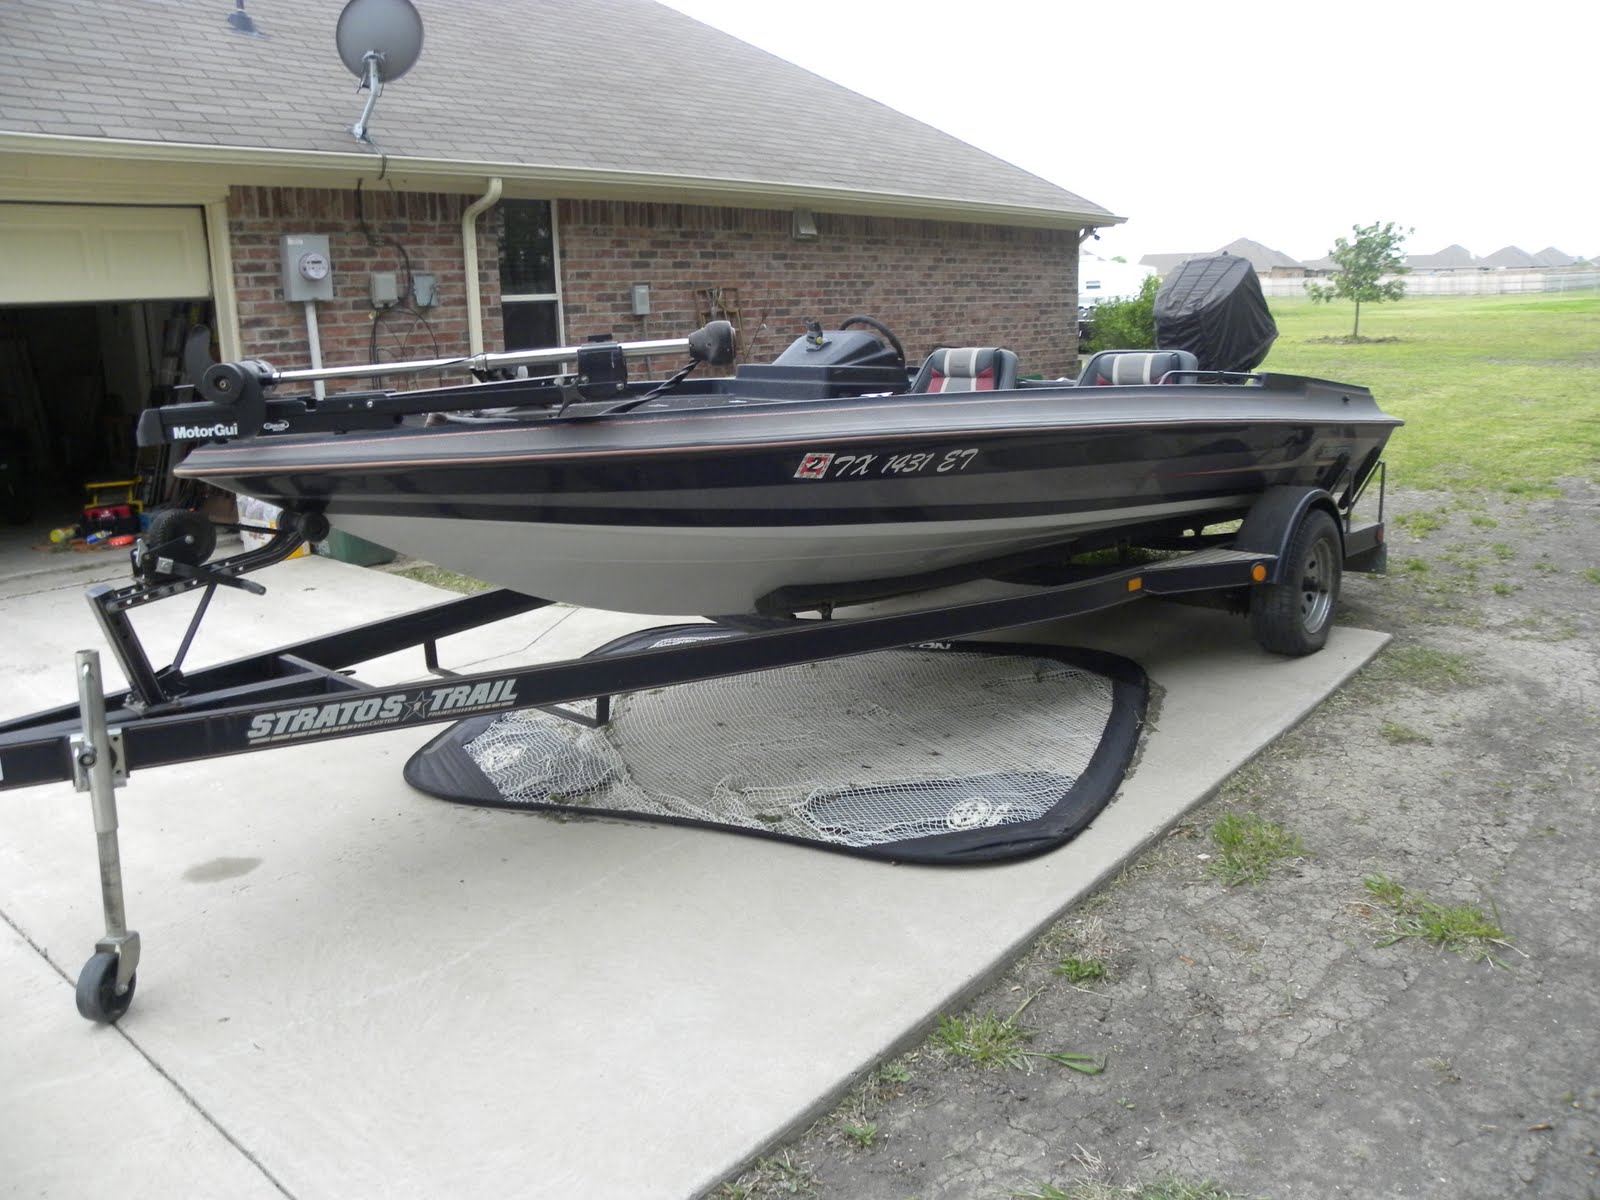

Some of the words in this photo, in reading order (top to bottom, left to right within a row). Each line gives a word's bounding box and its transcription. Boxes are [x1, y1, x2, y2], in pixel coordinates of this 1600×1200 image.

[173, 423, 238, 439] MotorGui
[834, 454, 878, 477] TX
[881, 452, 935, 474] 1431
[937, 448, 979, 473] ET
[247, 694, 407, 738] STRATOS
[429, 678, 518, 712] TRAIL
[369, 717, 400, 726] CUSTOM
